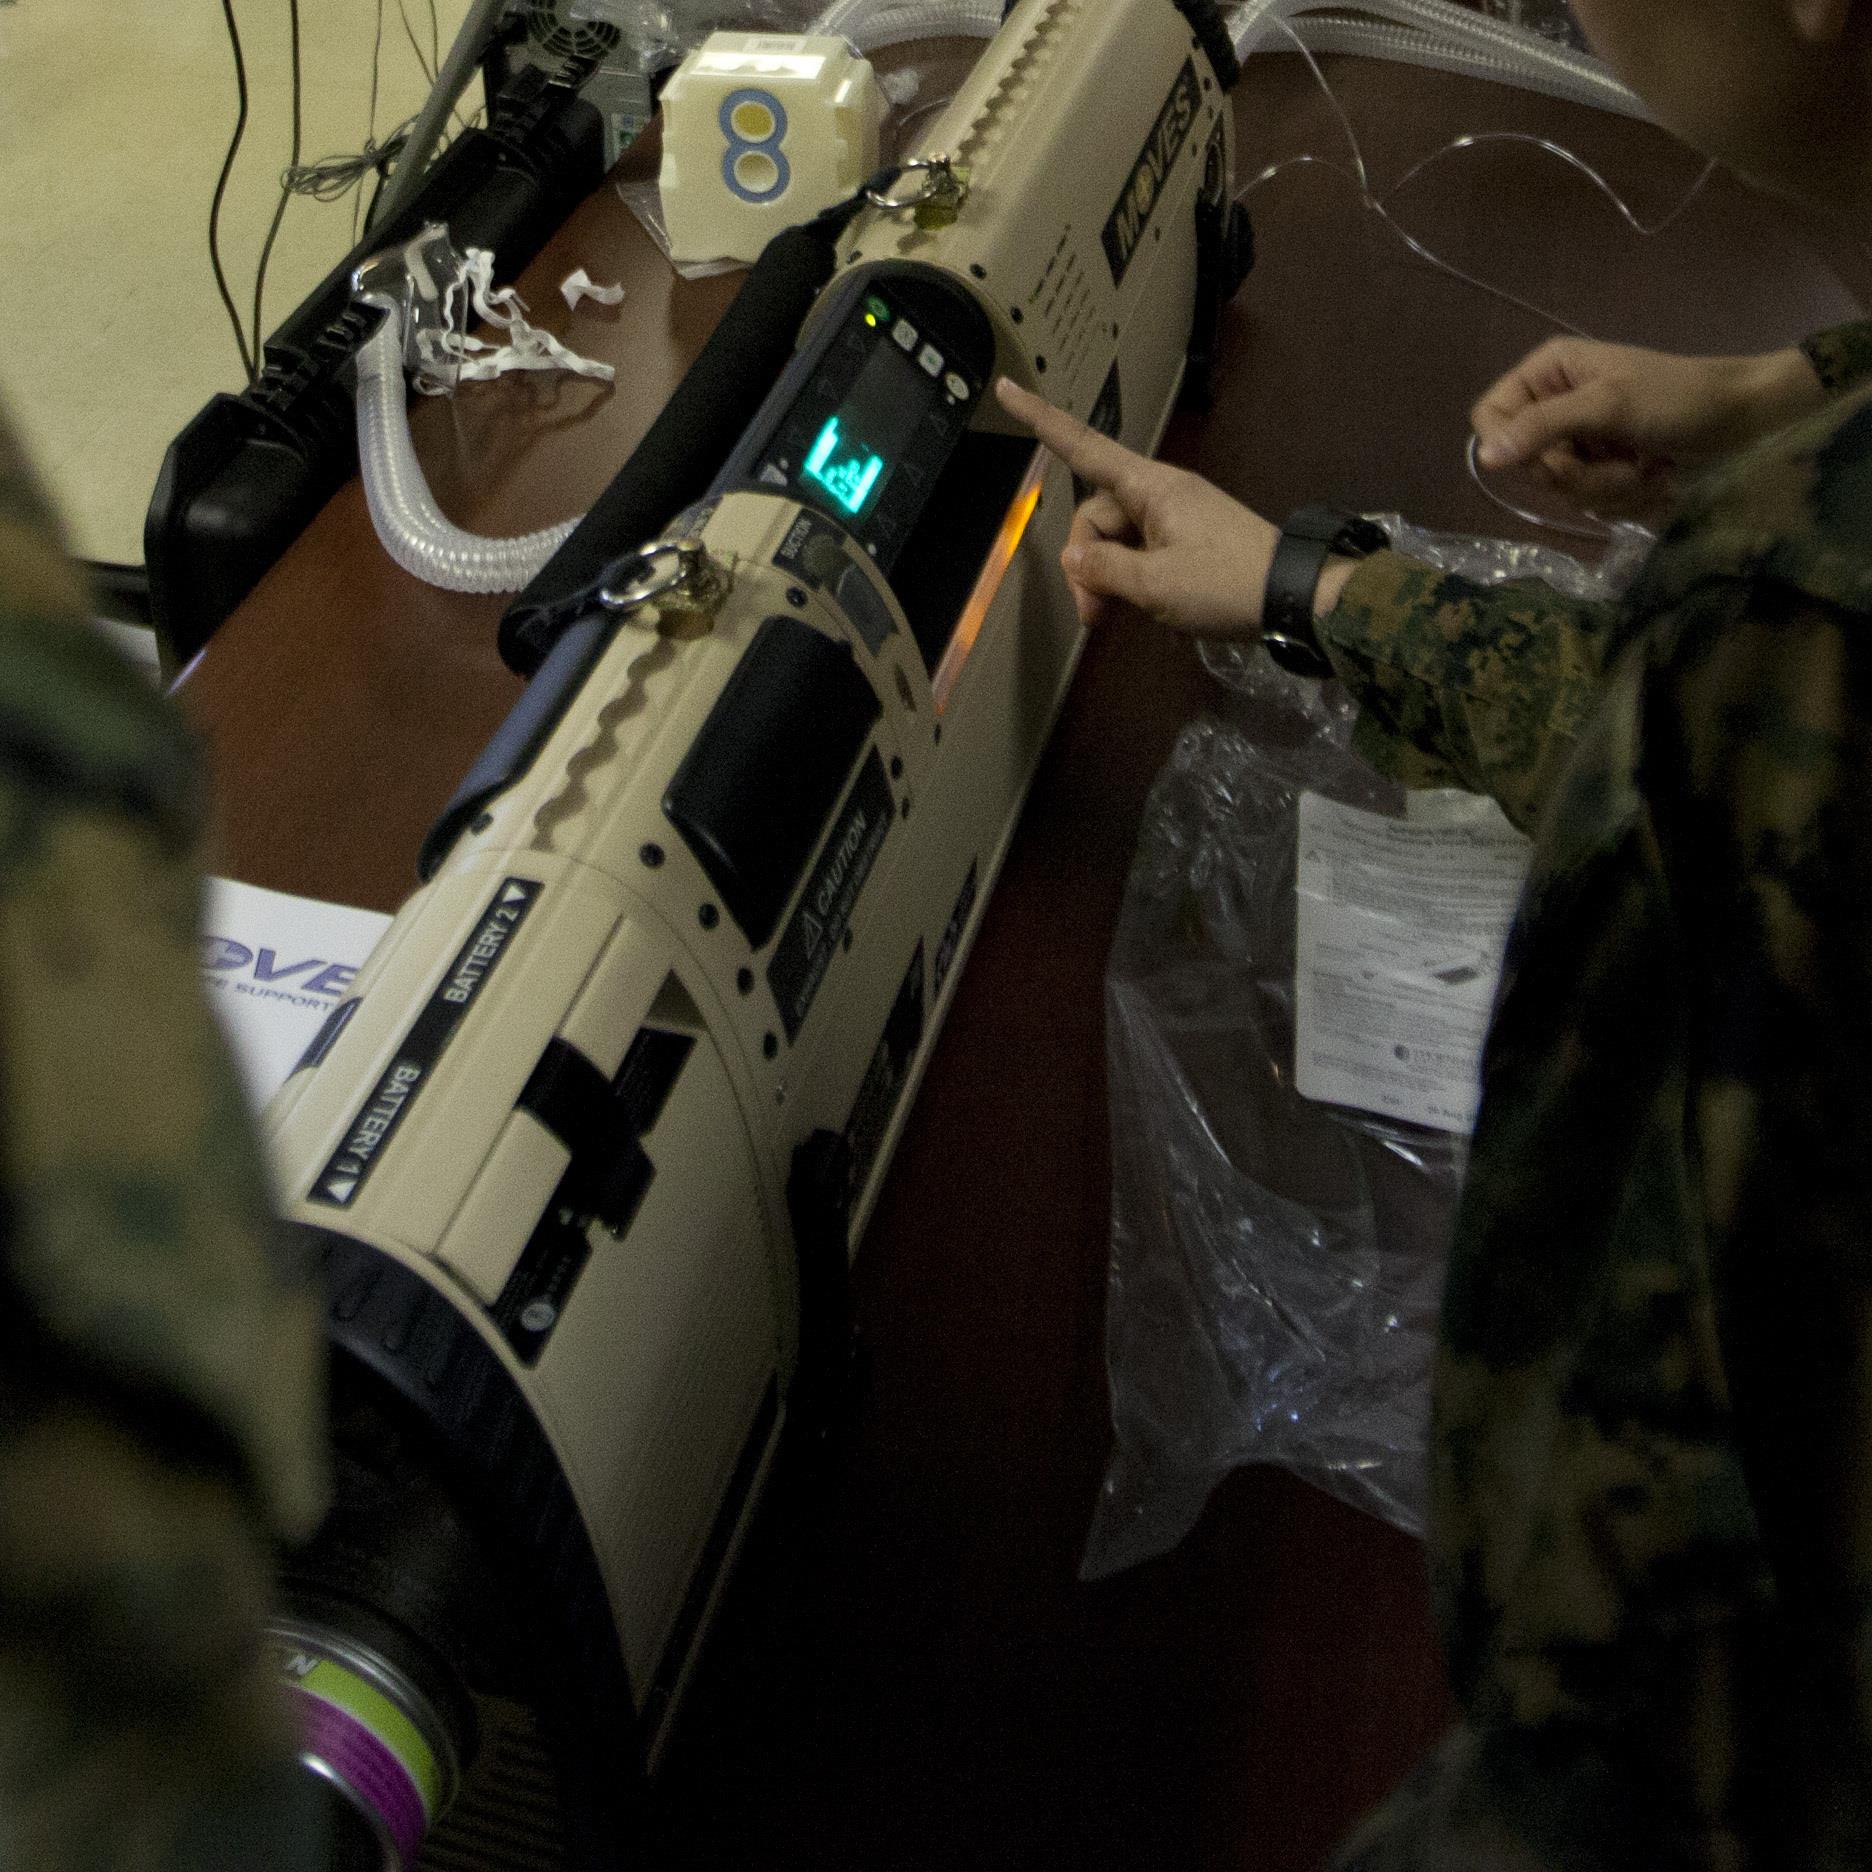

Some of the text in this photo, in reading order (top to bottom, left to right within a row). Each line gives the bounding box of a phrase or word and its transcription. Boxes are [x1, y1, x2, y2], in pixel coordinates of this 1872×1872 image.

[817, 808, 868, 917] CAUTION
[200, 933, 360, 998] OVE
[233, 982, 335, 1011] SUPPORT
[443, 907, 518, 1004] BATTERY 2
[336, 1064, 422, 1175] BATTERY 1
